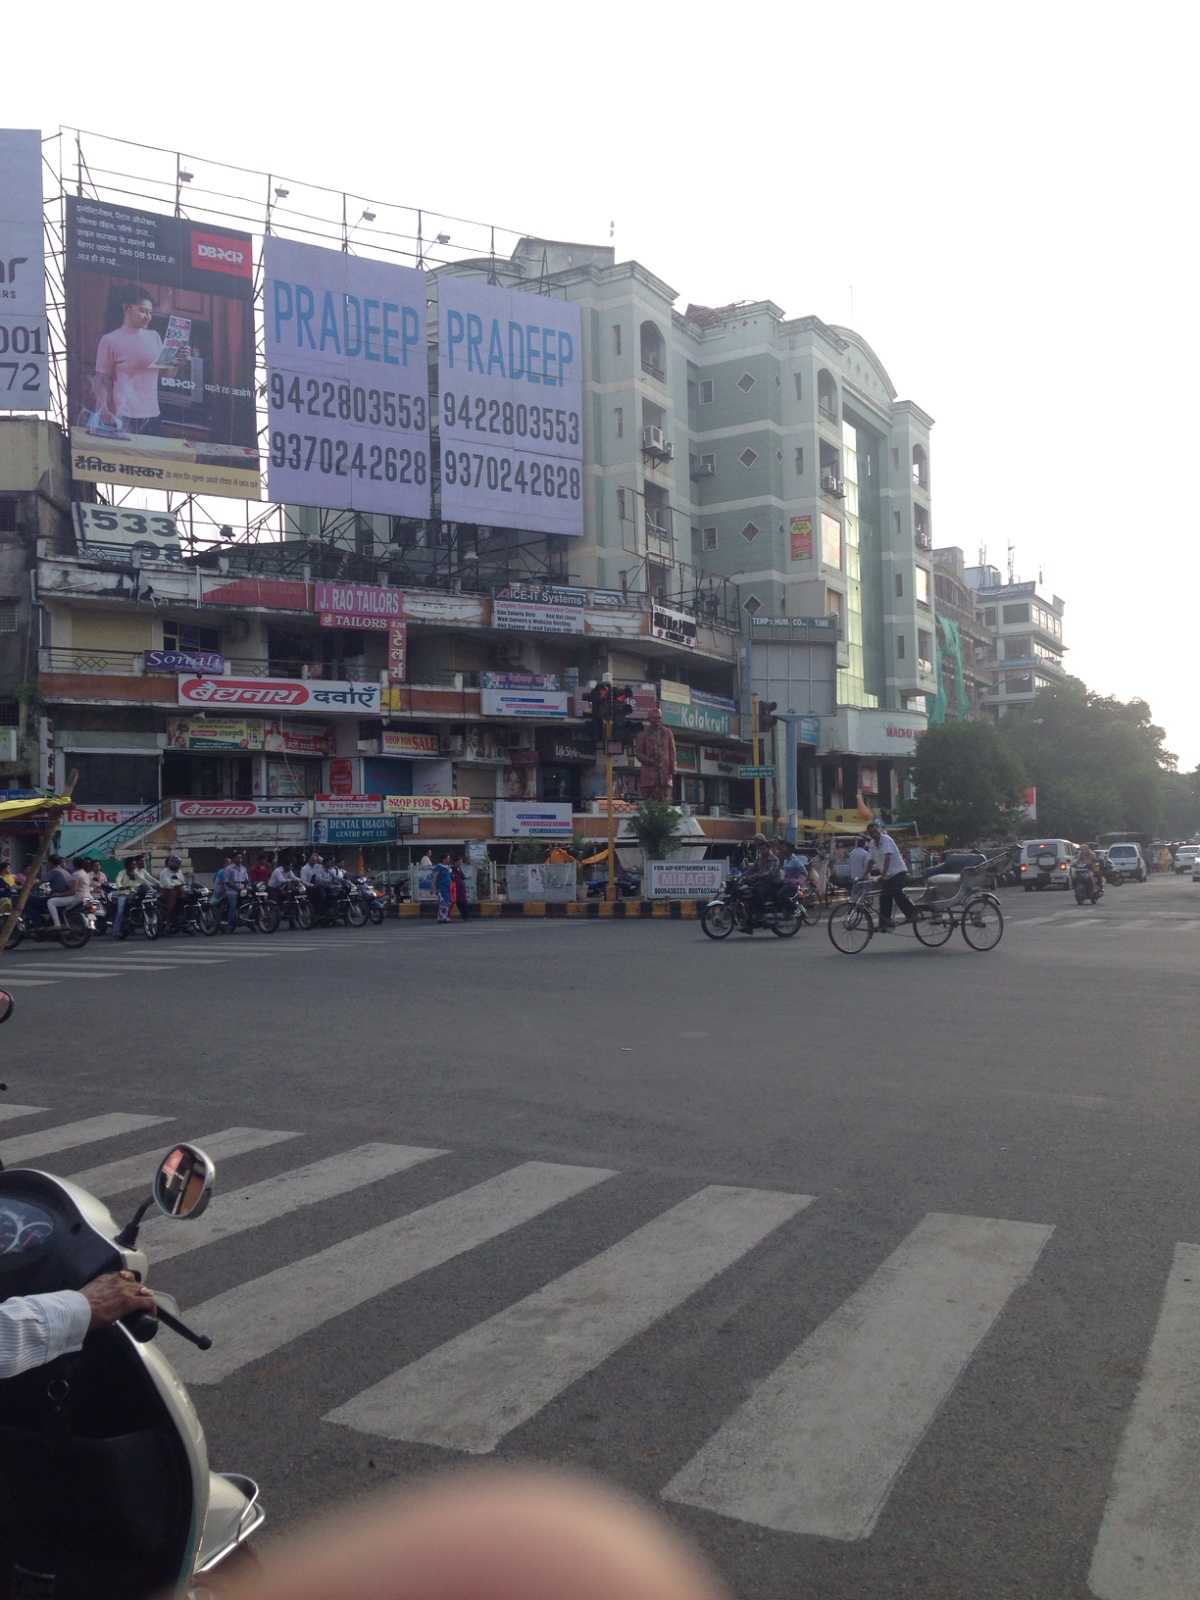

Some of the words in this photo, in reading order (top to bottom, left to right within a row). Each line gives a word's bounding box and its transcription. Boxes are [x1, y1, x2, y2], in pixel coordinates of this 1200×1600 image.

[134, 251, 145, 259] DB
[146, 253, 166, 263] STAR
[273, 280, 419, 367] PRADEEP
[447, 309, 573, 388] PRADEEP
[271, 373, 425, 431] 9422803553
[443, 392, 579, 445] 9422803553
[272, 431, 426, 485] 9370242628
[74, 455, 117, 474] दैनिक
[118, 463, 164, 480] भास्कर
[445, 450, 580, 500] 9370242628
[82, 508, 177, 537] 533
[320, 588, 329, 610] J.
[332, 588, 354, 611] RAO
[356, 590, 399, 614] TAILORS
[541, 592, 582, 605] Systems
[335, 615, 387, 628] TAILORS
[814, 619, 829, 627] TIME
[147, 651, 222, 666] Sonali
[189, 680, 302, 704] बैद्यनाथ
[681, 706, 729, 732] Kalakruti
[384, 735, 400, 745] SHOP
[400, 736, 412, 746] FOR
[412, 735, 437, 751] SALE
[555, 745, 565, 757] Life
[388, 798, 412, 808] SHOP
[413, 798, 431, 808] FOR
[431, 798, 470, 811] SALE
[68, 808, 118, 824] विनोद
[330, 819, 360, 829] DENTAL
[361, 819, 396, 829] IMAGING
[335, 830, 360, 838] CENTRE
[662, 873, 713, 885] MIRAGE
